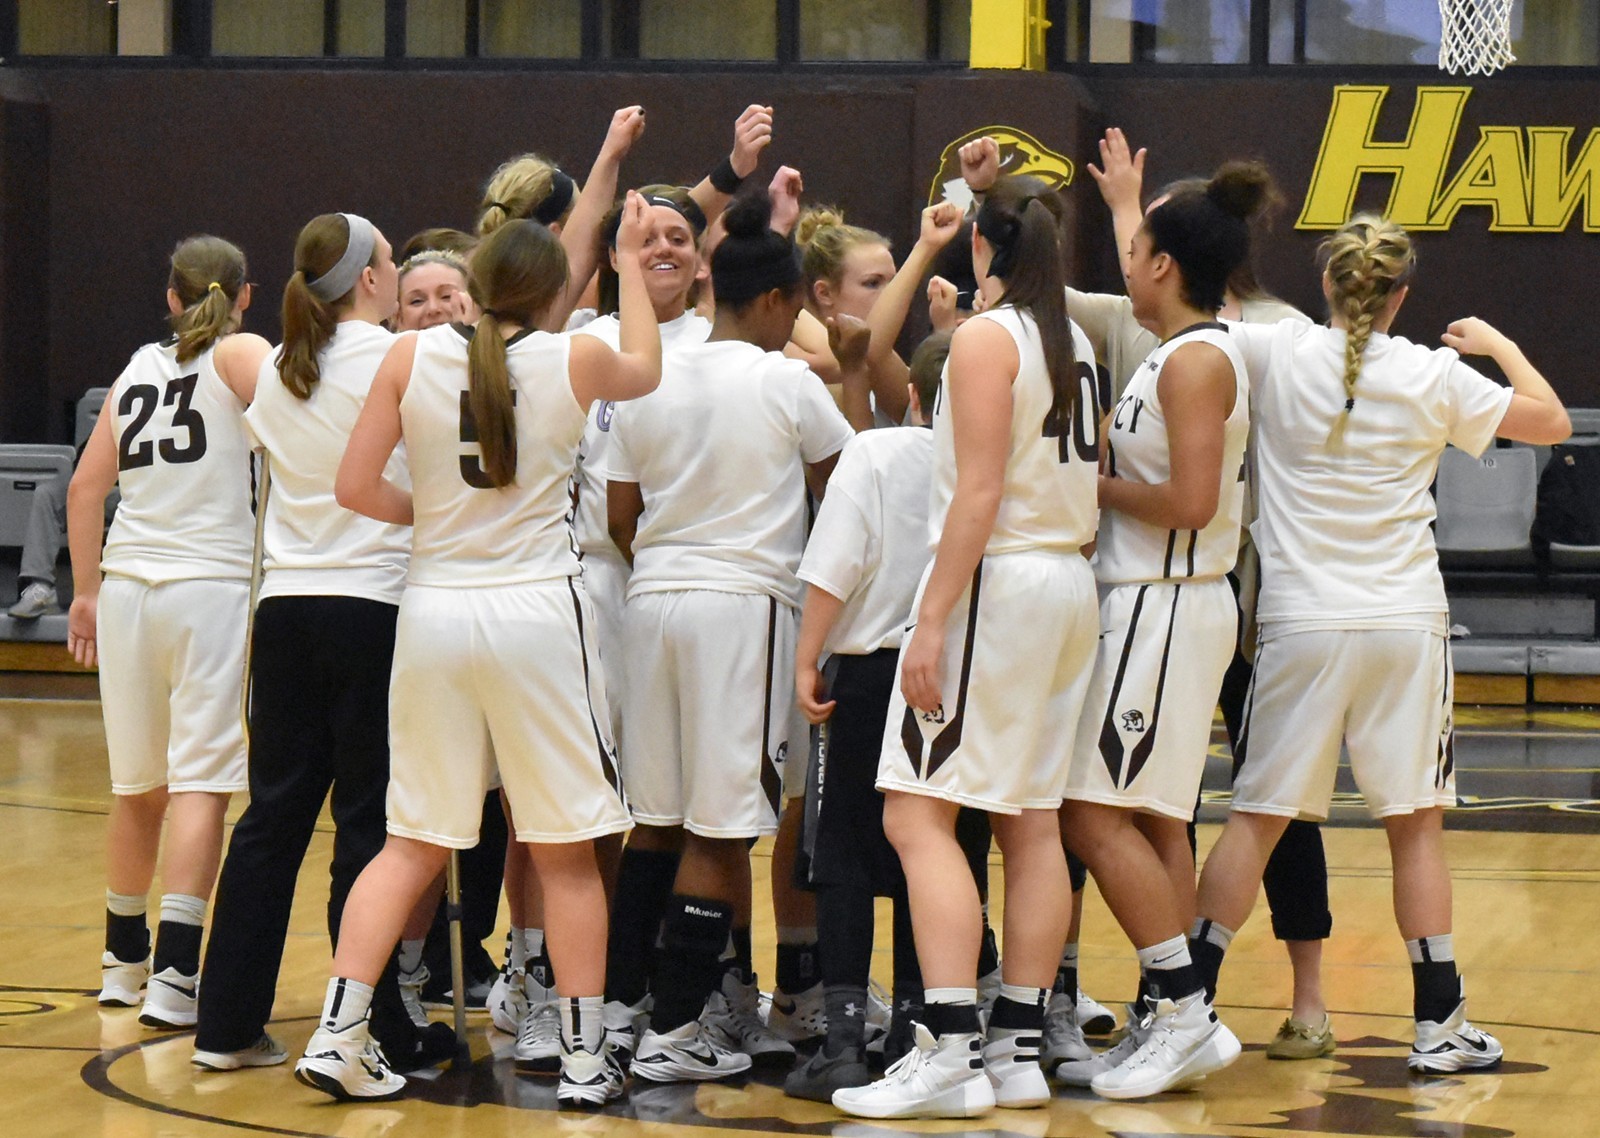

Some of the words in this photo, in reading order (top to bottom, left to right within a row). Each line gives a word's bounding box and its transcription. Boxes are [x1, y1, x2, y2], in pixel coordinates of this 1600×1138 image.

[118, 373, 207, 472] 23
[1114, 394, 1144, 434] CY
[1483, 458, 1494, 468] 10
